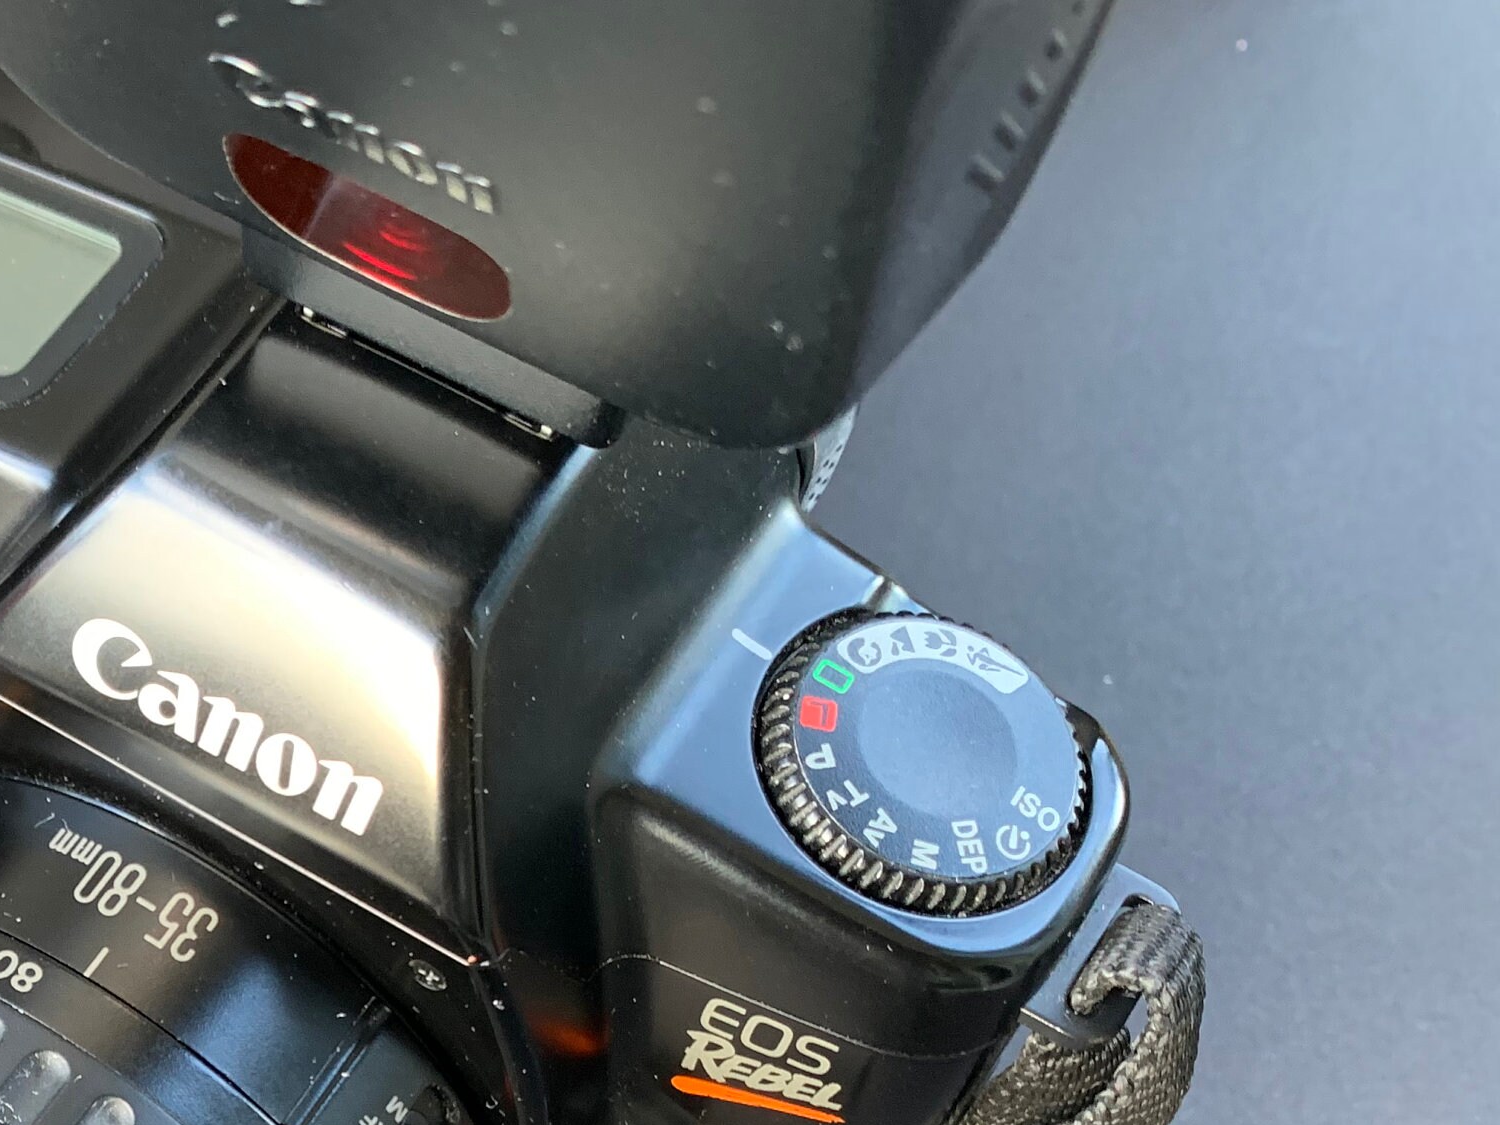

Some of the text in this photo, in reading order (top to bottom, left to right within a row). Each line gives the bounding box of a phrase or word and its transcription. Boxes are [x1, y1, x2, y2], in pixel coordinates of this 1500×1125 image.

[72, 618, 384, 836] Canon
[805, 743, 836, 769] P
[826, 780, 870, 811] Tv
[1010, 786, 1060, 831] ISO
[862, 808, 898, 848] Av
[951, 820, 988, 874] DEP
[910, 839, 940, 870] M
[48, 828, 220, 963] 35-80mm
[700, 998, 840, 1076] EOS
[681, 1030, 843, 1111] REBEL
[385, 1095, 409, 1123] M
